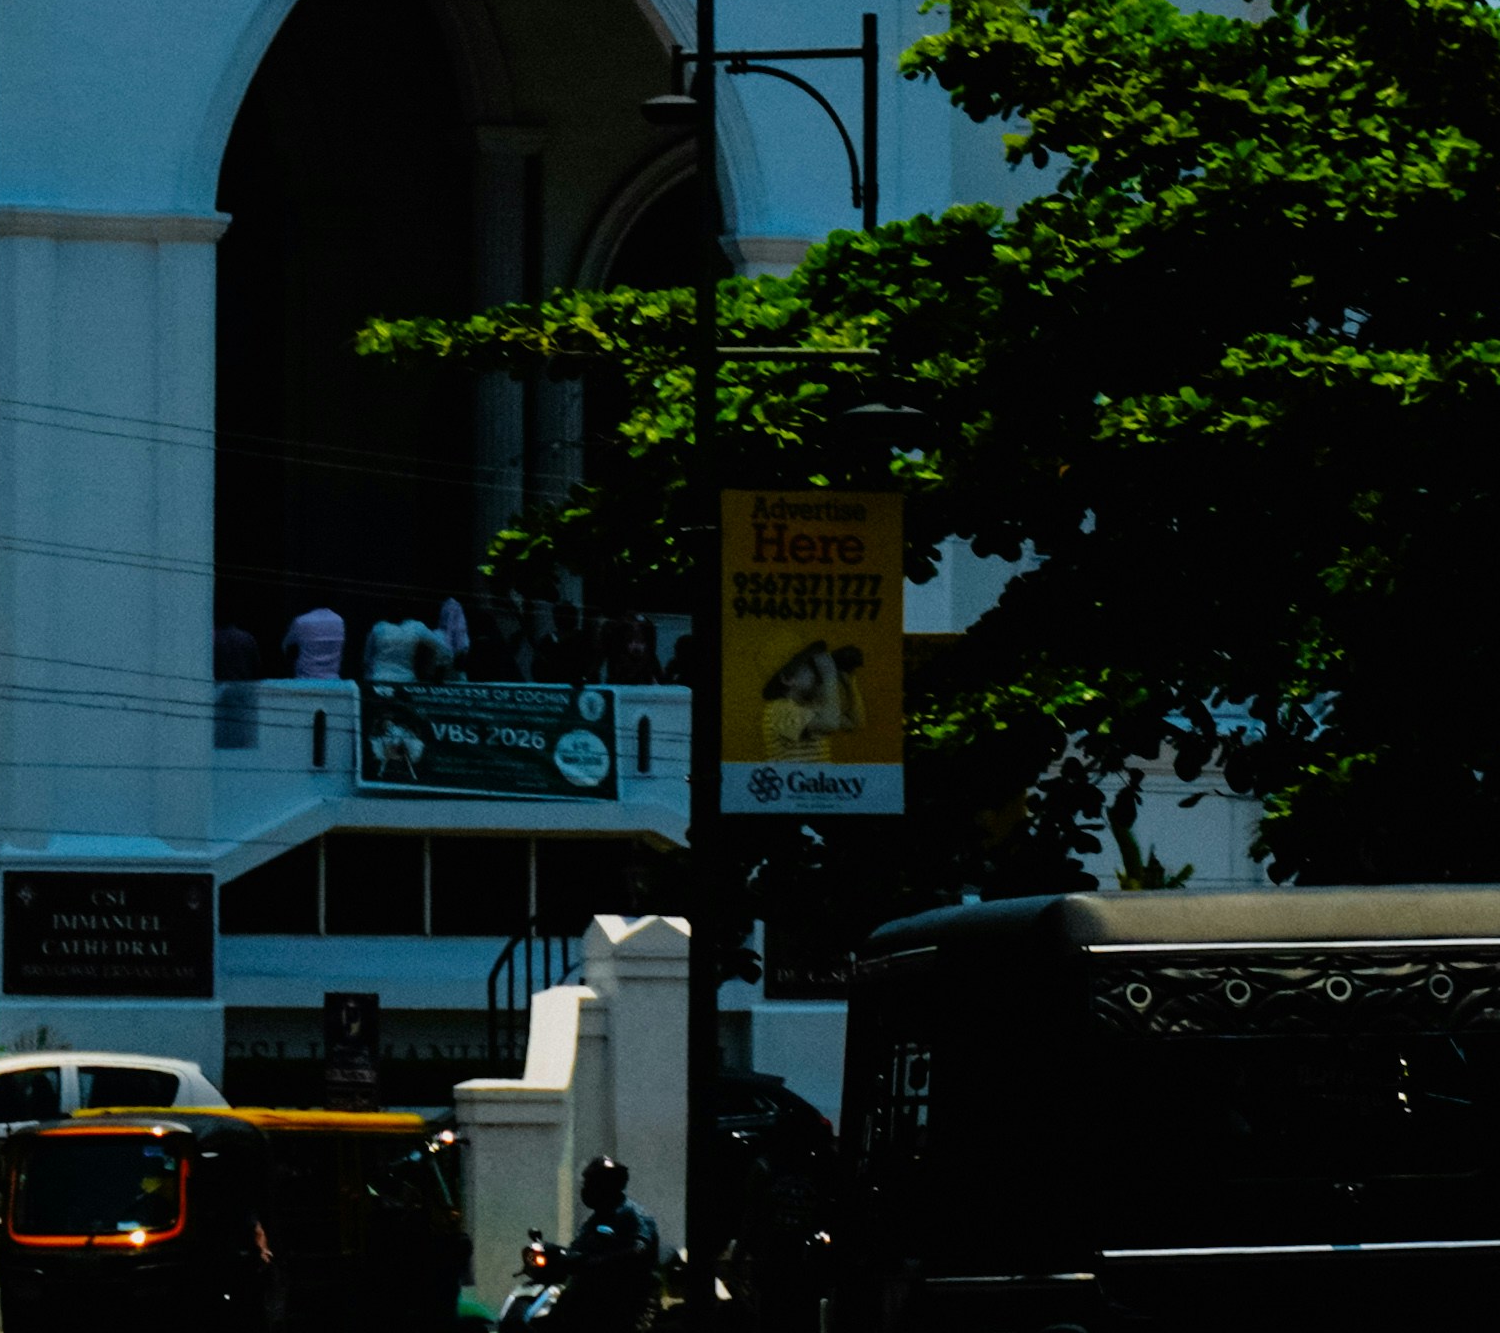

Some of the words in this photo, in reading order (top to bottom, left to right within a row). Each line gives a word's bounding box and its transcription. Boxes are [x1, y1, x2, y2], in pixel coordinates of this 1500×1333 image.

[751, 496, 867, 522] Advertise
[752, 523, 865, 565] Here
[732, 571, 883, 597] 9567371777
[429, 720, 481, 746] VBS
[485, 725, 547, 751] 2026
[786, 770, 867, 800] Galaxy
[90, 889, 128, 907] CSI
[51, 912, 164, 932] IMMANUEL
[40, 939, 172, 957] CATHEDRAL
